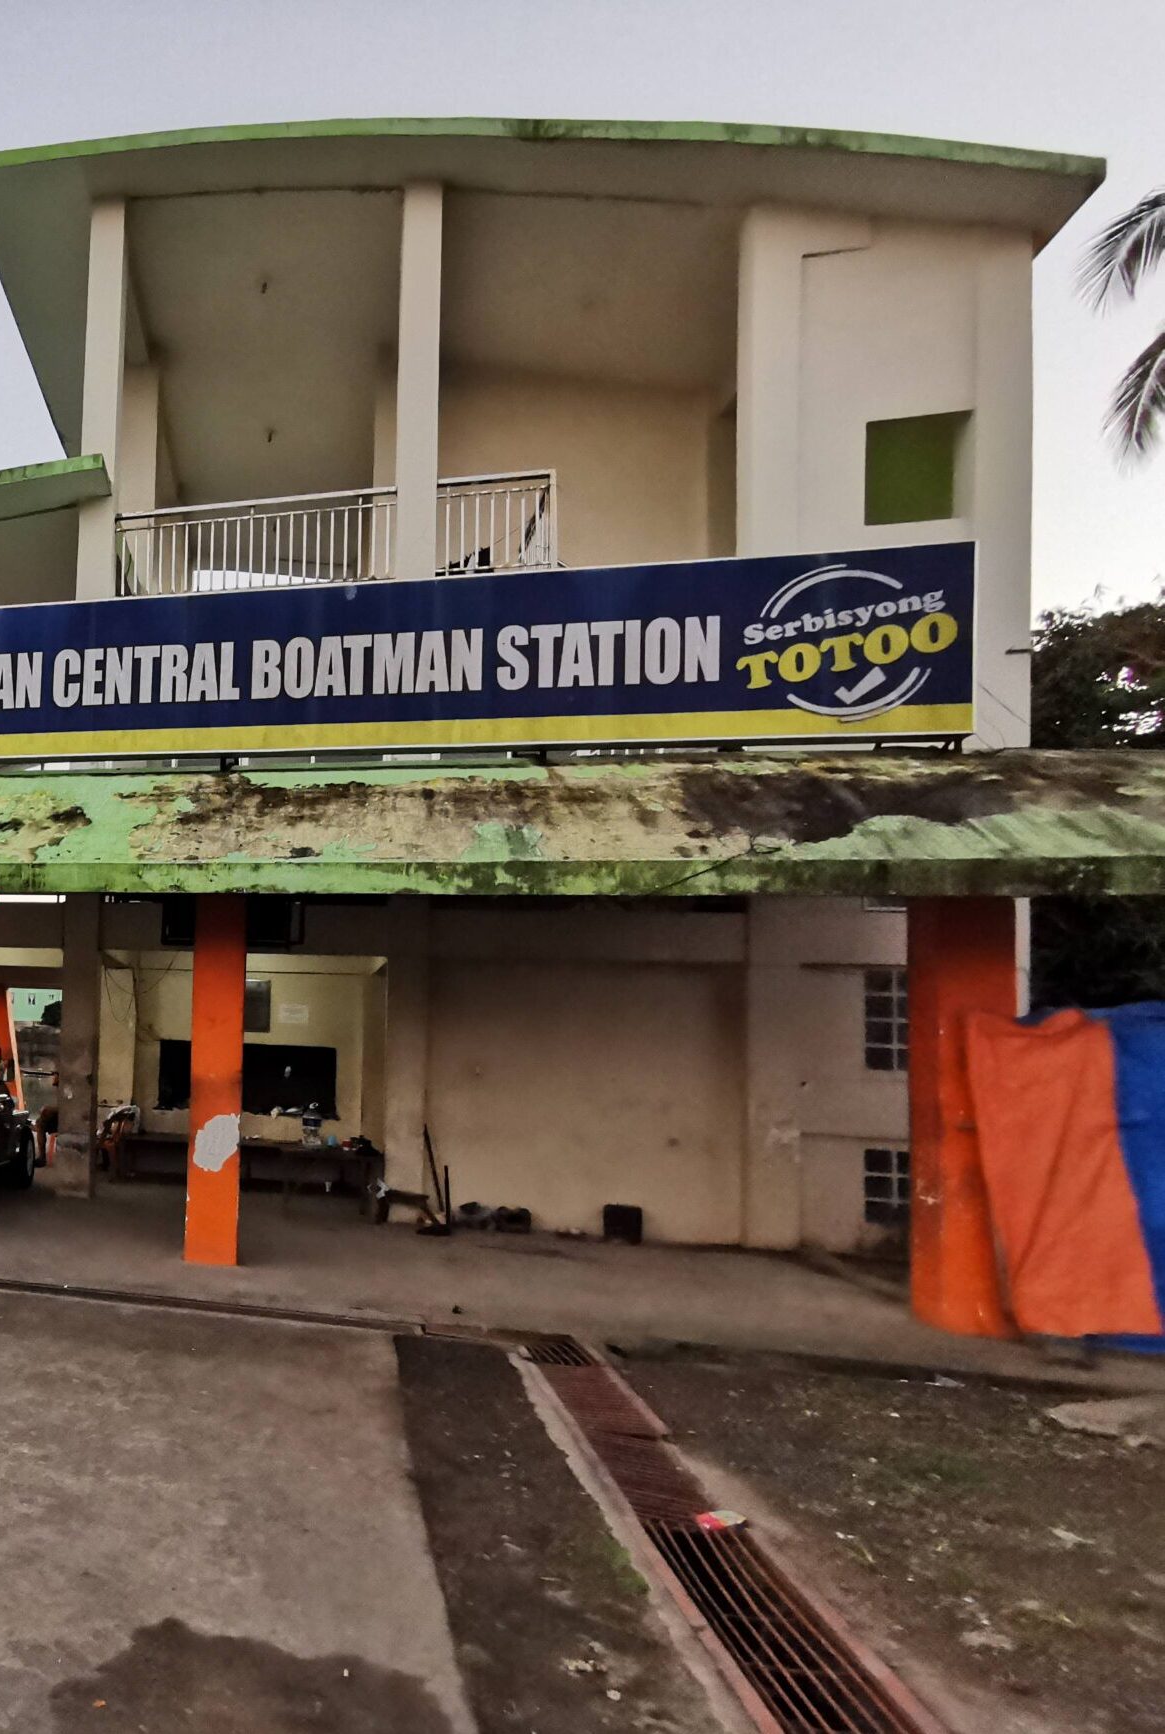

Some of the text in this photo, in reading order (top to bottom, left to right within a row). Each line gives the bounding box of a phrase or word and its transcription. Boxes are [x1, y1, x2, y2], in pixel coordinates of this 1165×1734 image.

[736, 612, 958, 689] TOTOO
[743, 589, 945, 645] Serbisyong
[52, 641, 240, 708] CENTRAL
[251, 628, 483, 699] BOATMAN
[496, 615, 720, 691] STATION
